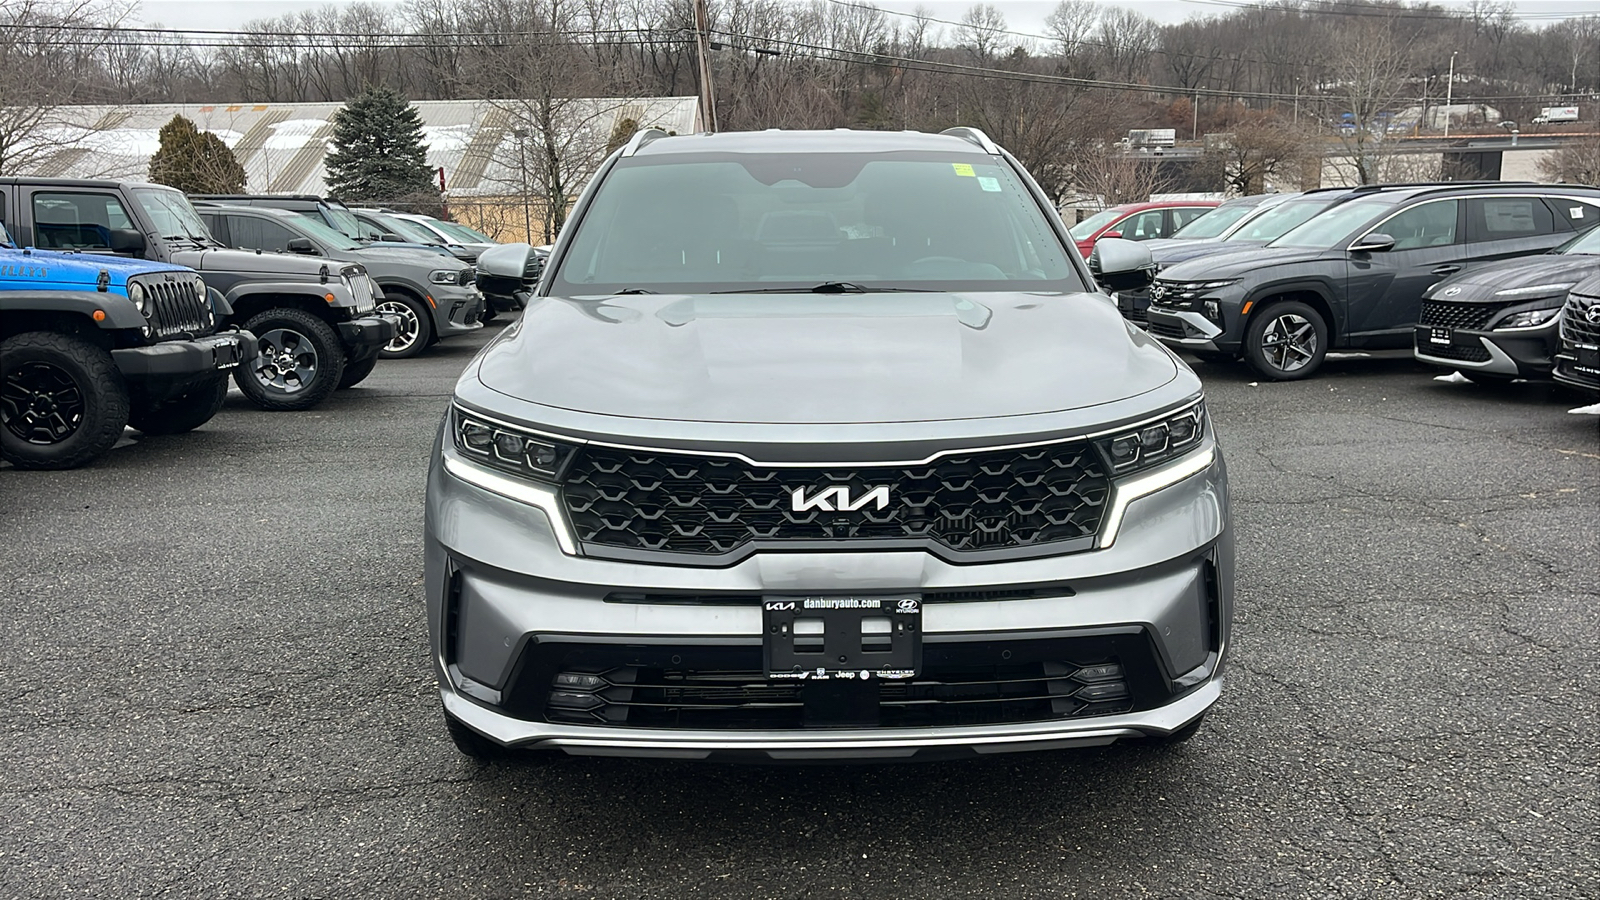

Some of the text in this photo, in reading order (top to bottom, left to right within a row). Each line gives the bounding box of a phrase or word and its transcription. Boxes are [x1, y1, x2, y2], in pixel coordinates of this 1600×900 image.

[792, 485, 890, 511] KIA
[766, 602, 795, 611] KIA
[803, 598, 881, 610] danburyauto.com
[835, 670, 855, 680] Jeep
